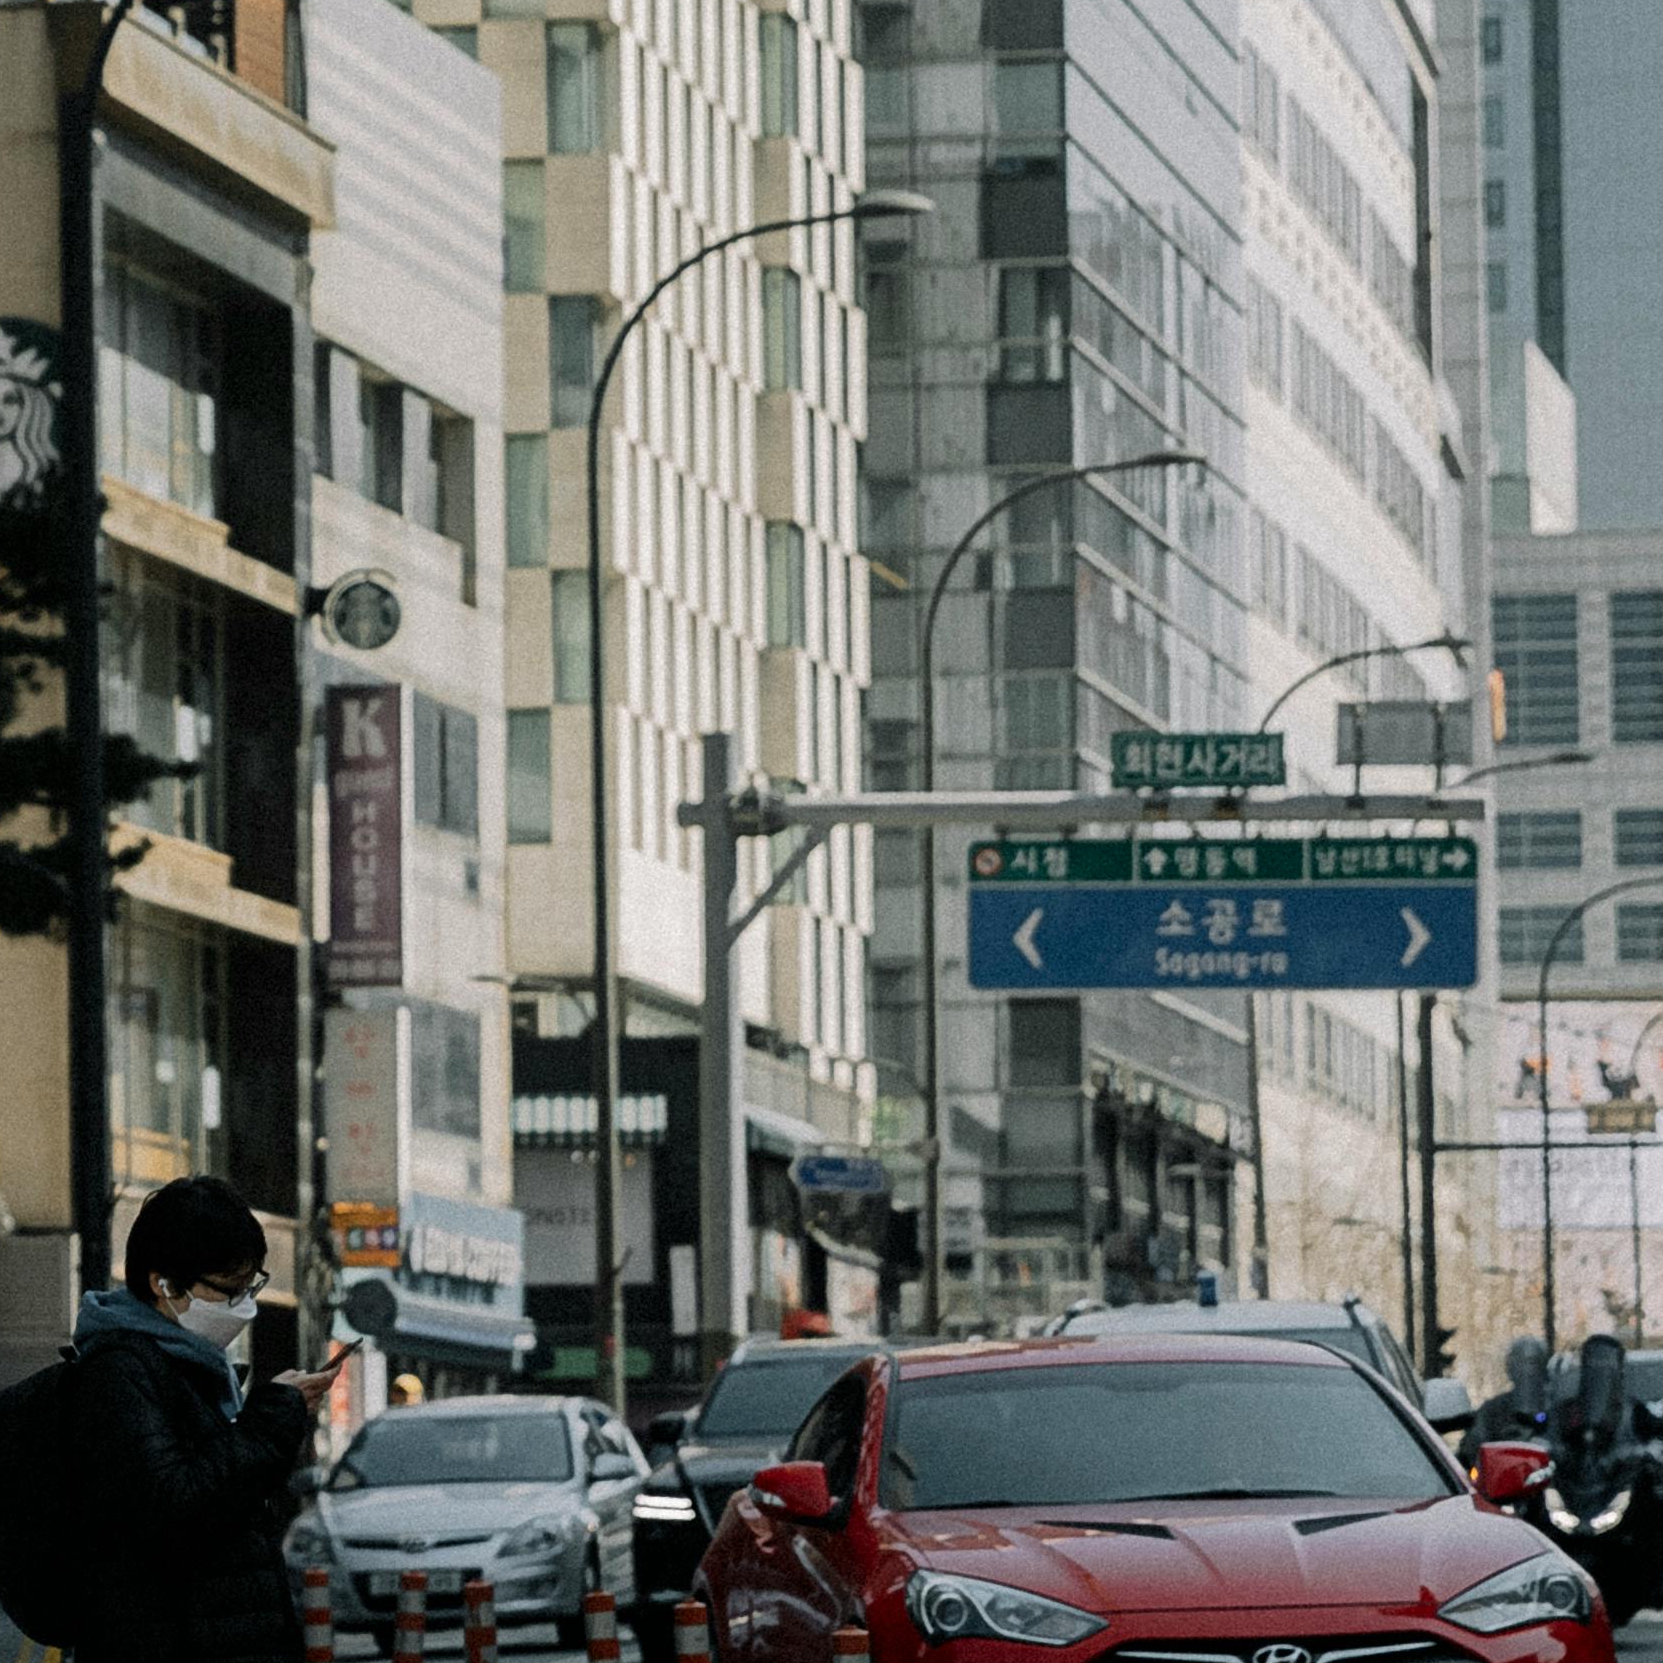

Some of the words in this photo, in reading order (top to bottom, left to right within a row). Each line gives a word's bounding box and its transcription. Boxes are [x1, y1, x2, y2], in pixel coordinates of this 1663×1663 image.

[1126, 738, 1279, 779] 회현사거리
[1155, 898, 1287, 945] 소공로
[1155, 946, 1287, 980] Sogong-ro
